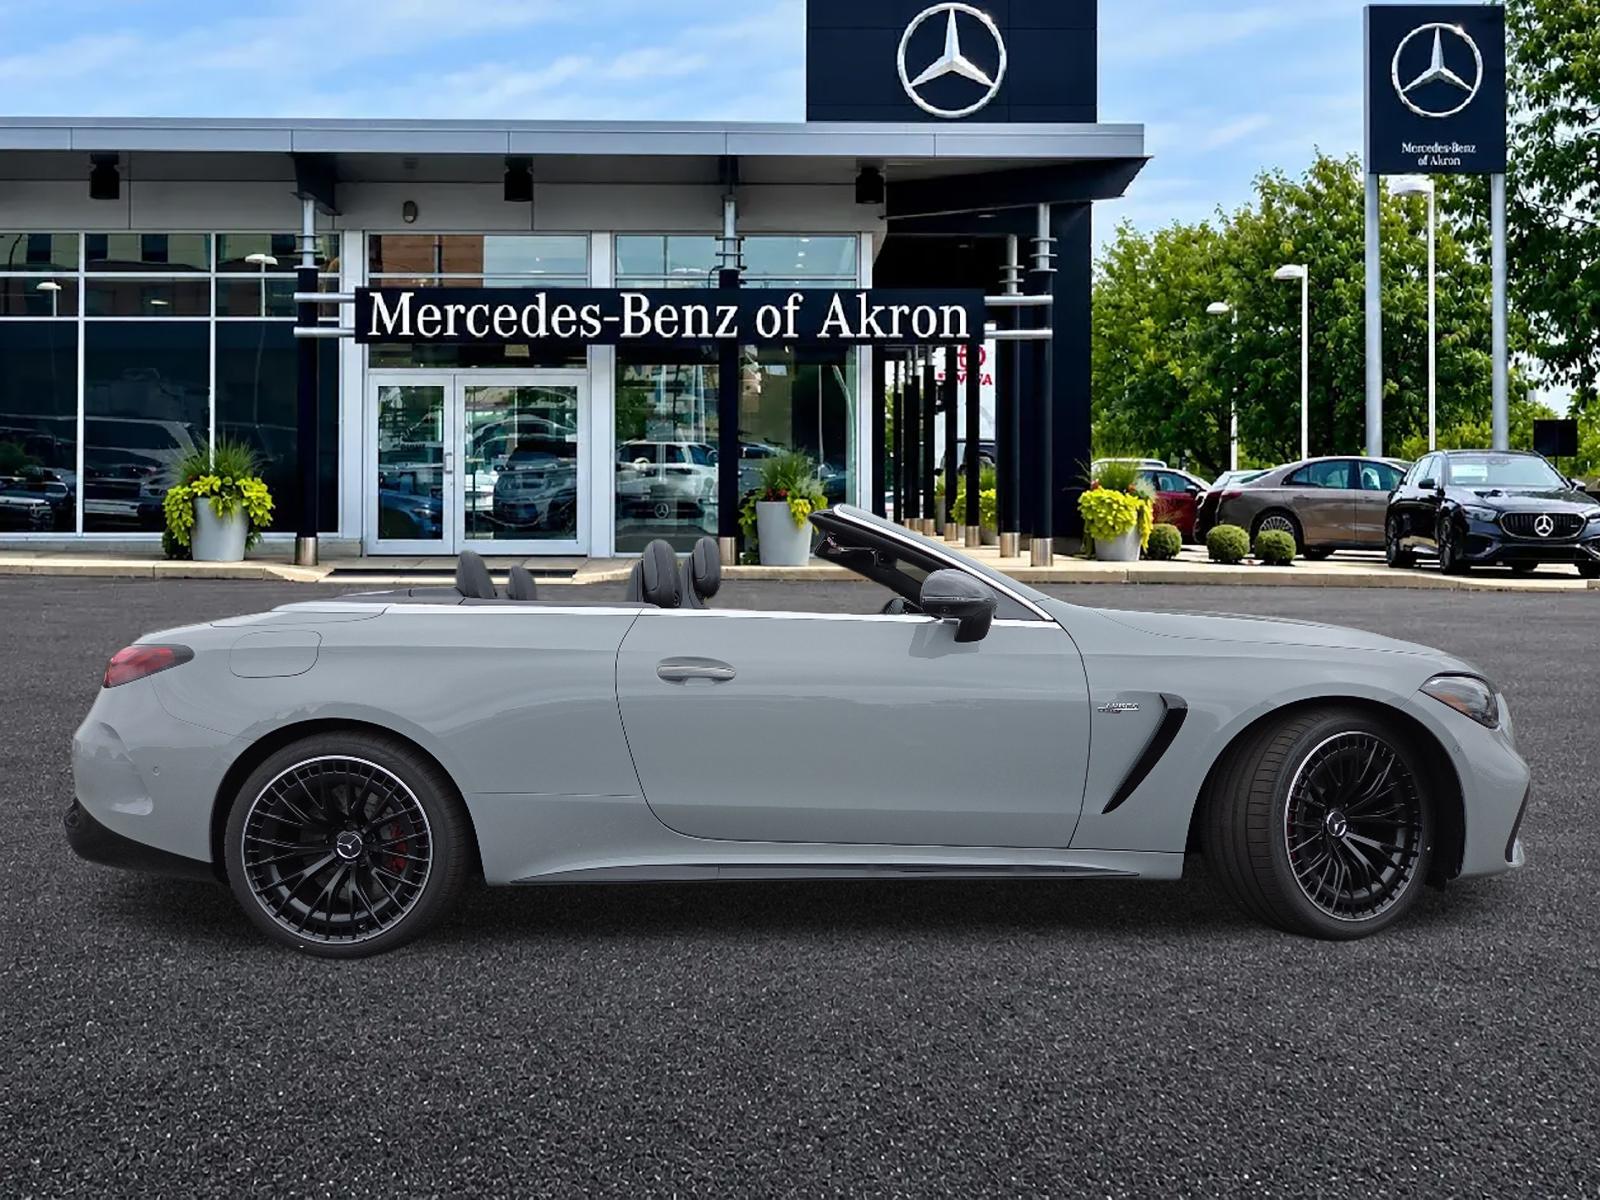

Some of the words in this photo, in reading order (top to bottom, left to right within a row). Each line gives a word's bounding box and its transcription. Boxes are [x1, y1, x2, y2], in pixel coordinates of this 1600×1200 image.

[1401, 142, 1477, 154] Mercedes-Benz
[1417, 154, 1429, 166] of
[1430, 154, 1461, 166] Akron
[367, 291, 739, 338] Mercedes-Benz
[755, 292, 804, 338] of
[816, 291, 971, 338] Akron
